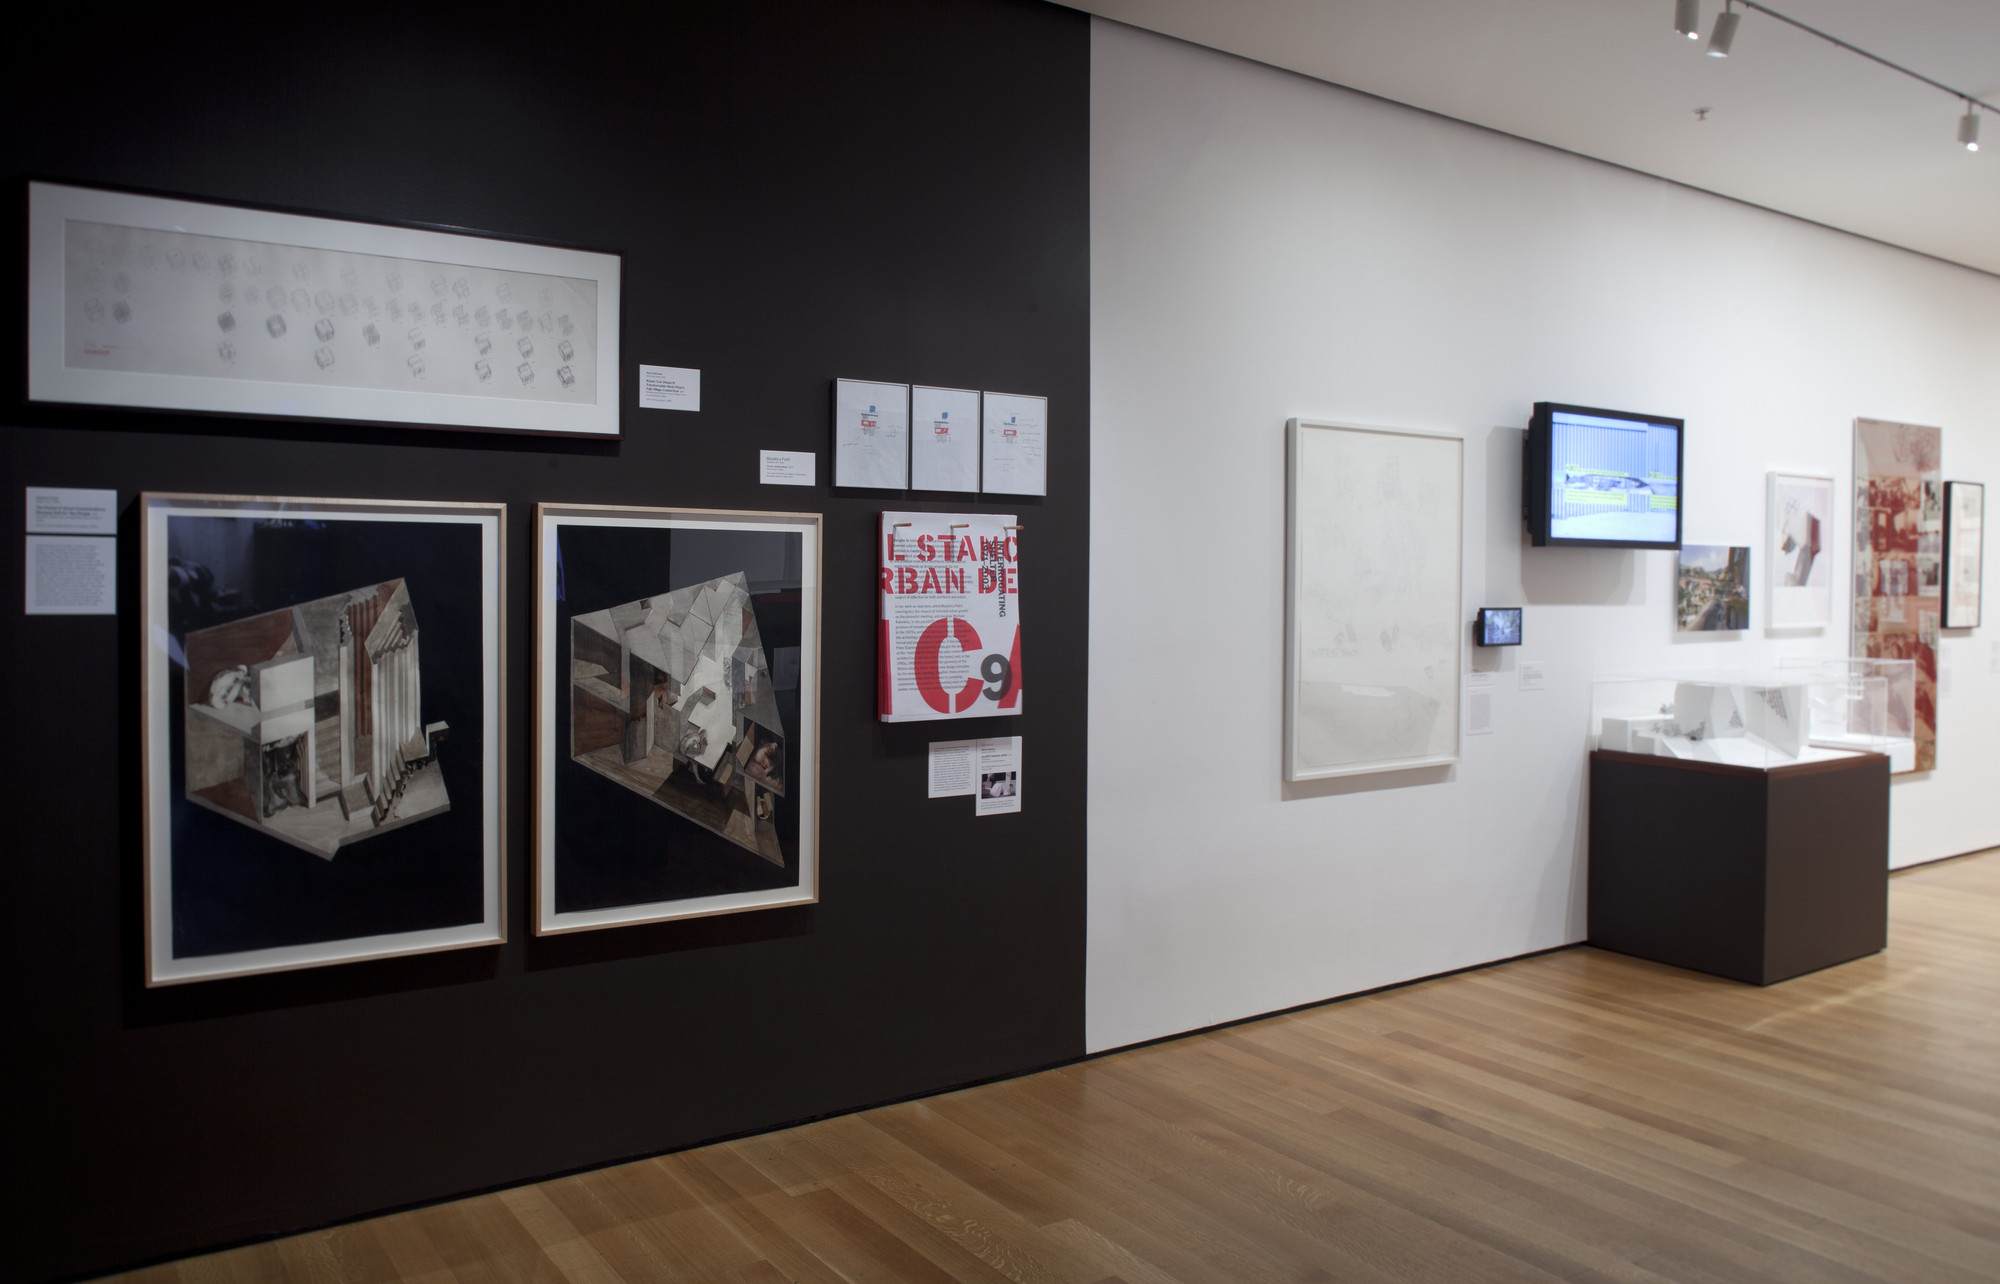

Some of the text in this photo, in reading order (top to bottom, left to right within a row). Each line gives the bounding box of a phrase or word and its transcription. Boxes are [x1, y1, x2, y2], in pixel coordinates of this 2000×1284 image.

[989, 540, 997, 582] SHELTER
[997, 540, 1006, 618] INTERROGATING
[981, 653, 1012, 701] 9
